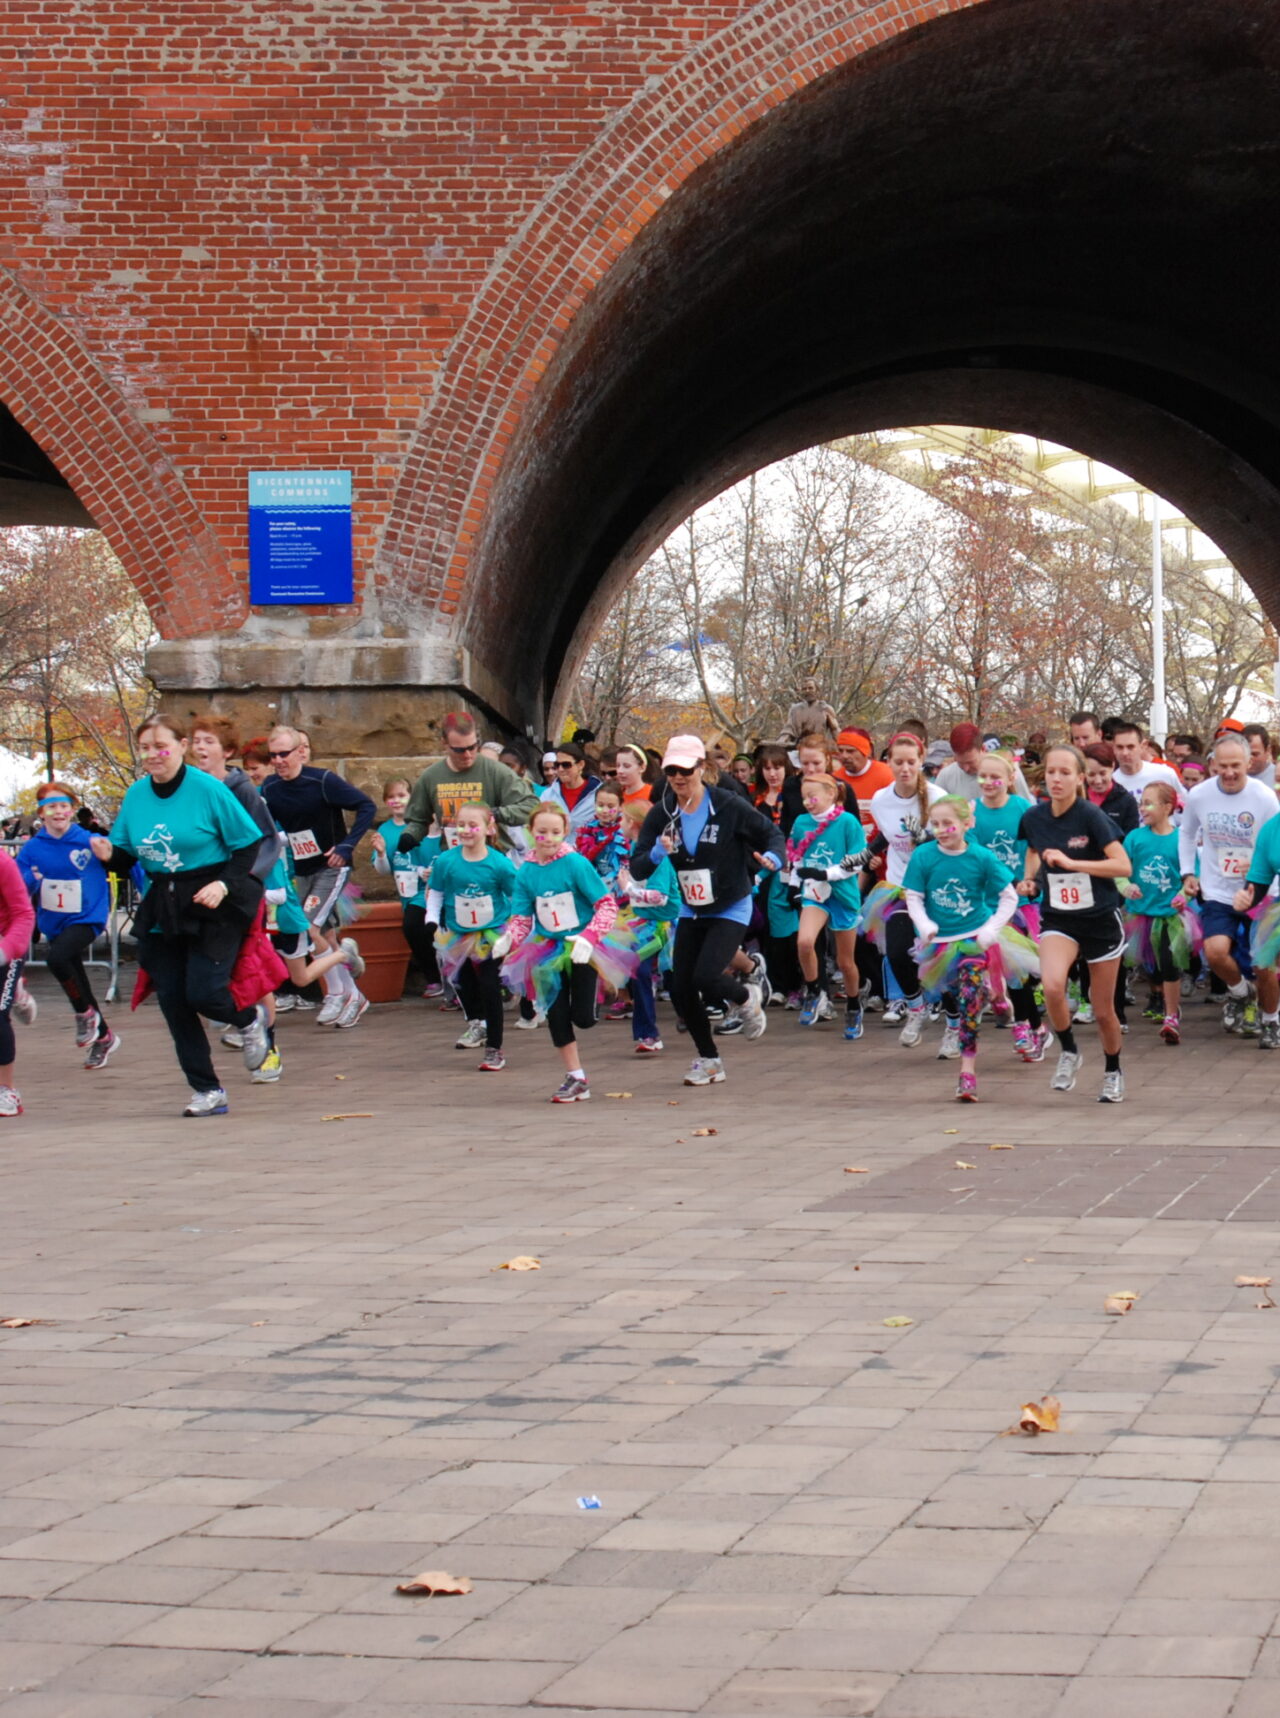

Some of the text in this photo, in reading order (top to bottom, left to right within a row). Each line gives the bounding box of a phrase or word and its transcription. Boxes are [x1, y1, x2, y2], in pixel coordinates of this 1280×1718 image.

[256, 477, 343, 487] BICENTENNIAL
[271, 488, 329, 497] COMMONS
[1223, 858, 1241, 874] 72
[57, 894, 63, 908] 1
[1060, 887, 1080, 904] 89
[470, 911, 477, 924] 1
[552, 911, 560, 927] 1
[0, 958, 23, 1011] bercrombie
